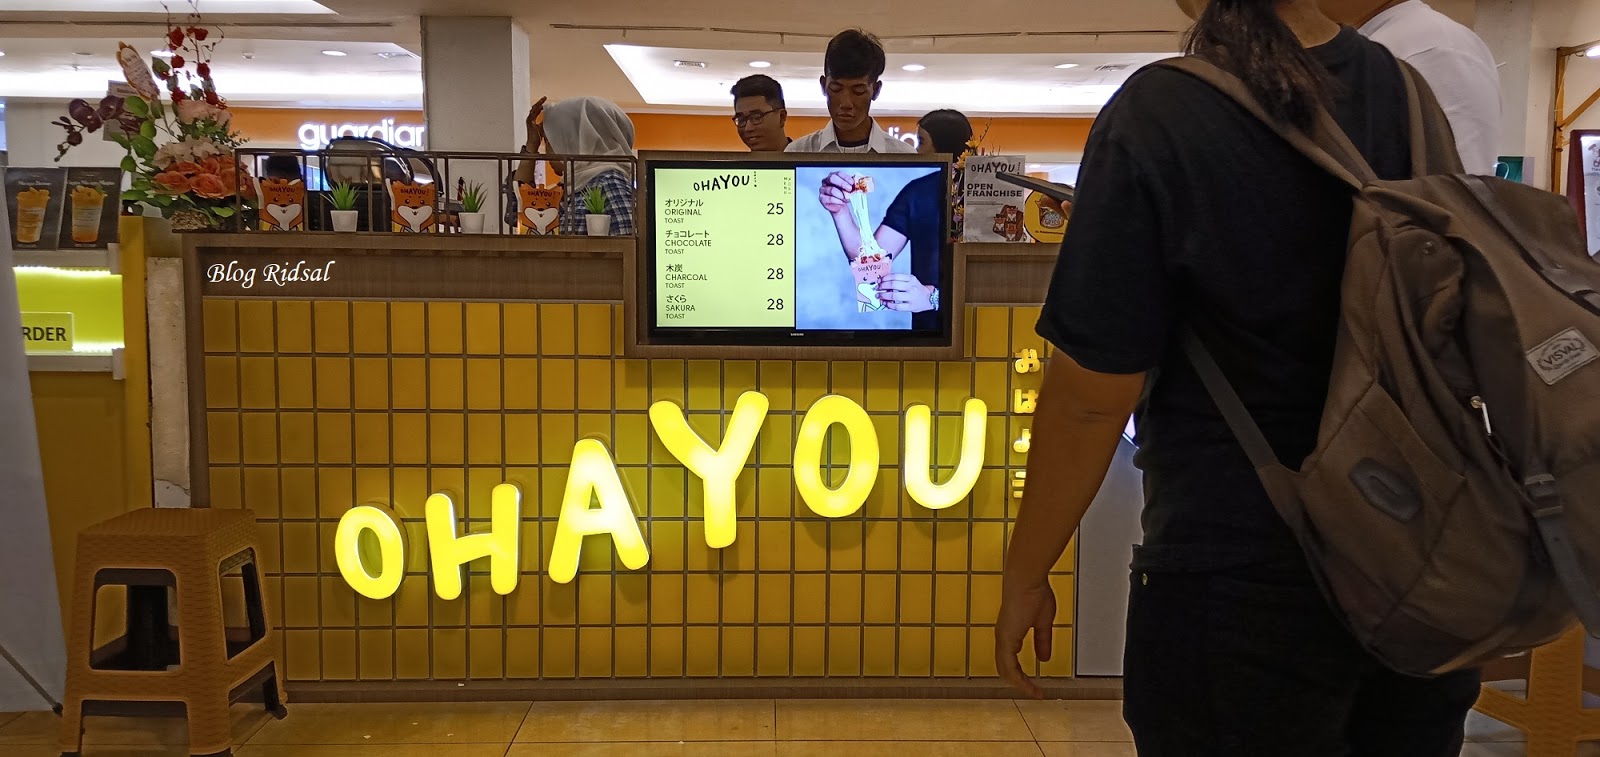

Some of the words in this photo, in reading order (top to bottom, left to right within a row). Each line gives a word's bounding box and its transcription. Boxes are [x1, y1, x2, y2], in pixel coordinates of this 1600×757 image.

[665, 198, 704, 207] オリジナル
[664, 208, 702, 216] ORIGINAL
[767, 202, 784, 215] 25
[665, 229, 710, 239] チョコレート
[767, 233, 784, 246] 28
[664, 239, 712, 247] CHOCOLATE
[665, 273, 708, 281] CHARCOAL
[767, 267, 784, 280] 28
[666, 294, 687, 304] さくら
[767, 298, 784, 311] 28
[665, 304, 696, 312] SAKURA
[21, 326, 67, 342] RDER
[1543, 342, 1582, 365] VISVAL
[335, 391, 987, 600] OHAYOU
